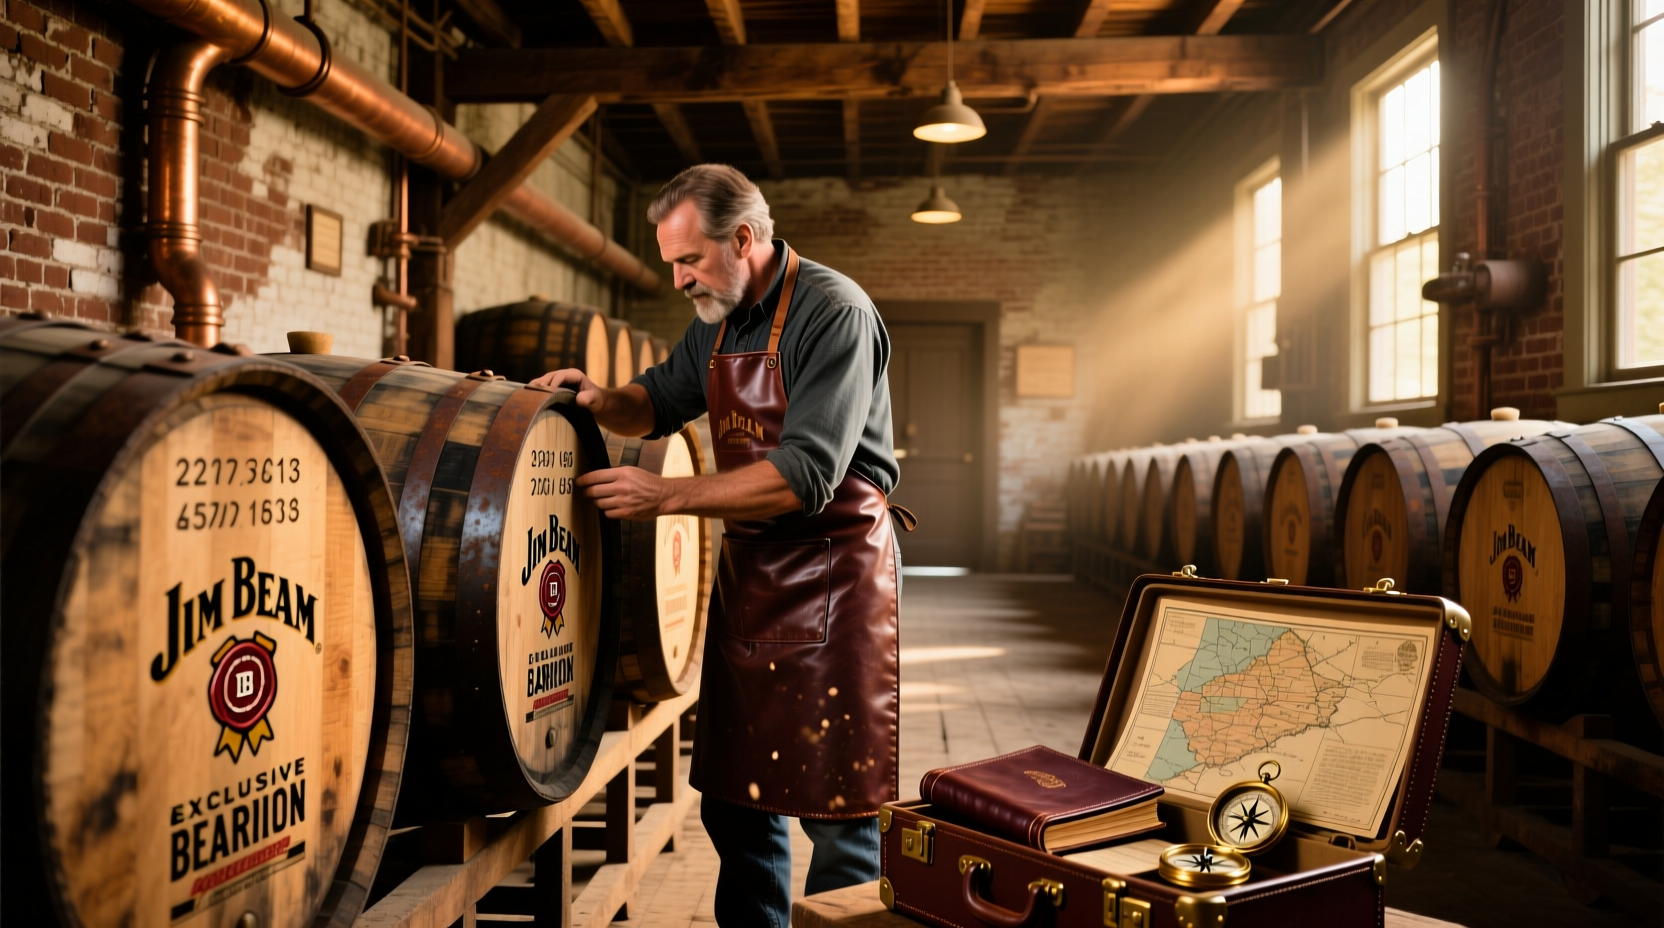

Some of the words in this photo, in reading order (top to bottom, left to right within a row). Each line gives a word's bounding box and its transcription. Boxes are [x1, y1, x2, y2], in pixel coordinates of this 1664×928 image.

[150, 581, 225, 683] JIM
[231, 556, 319, 647] BEAM
[170, 757, 305, 826] EXCLUSIVE
